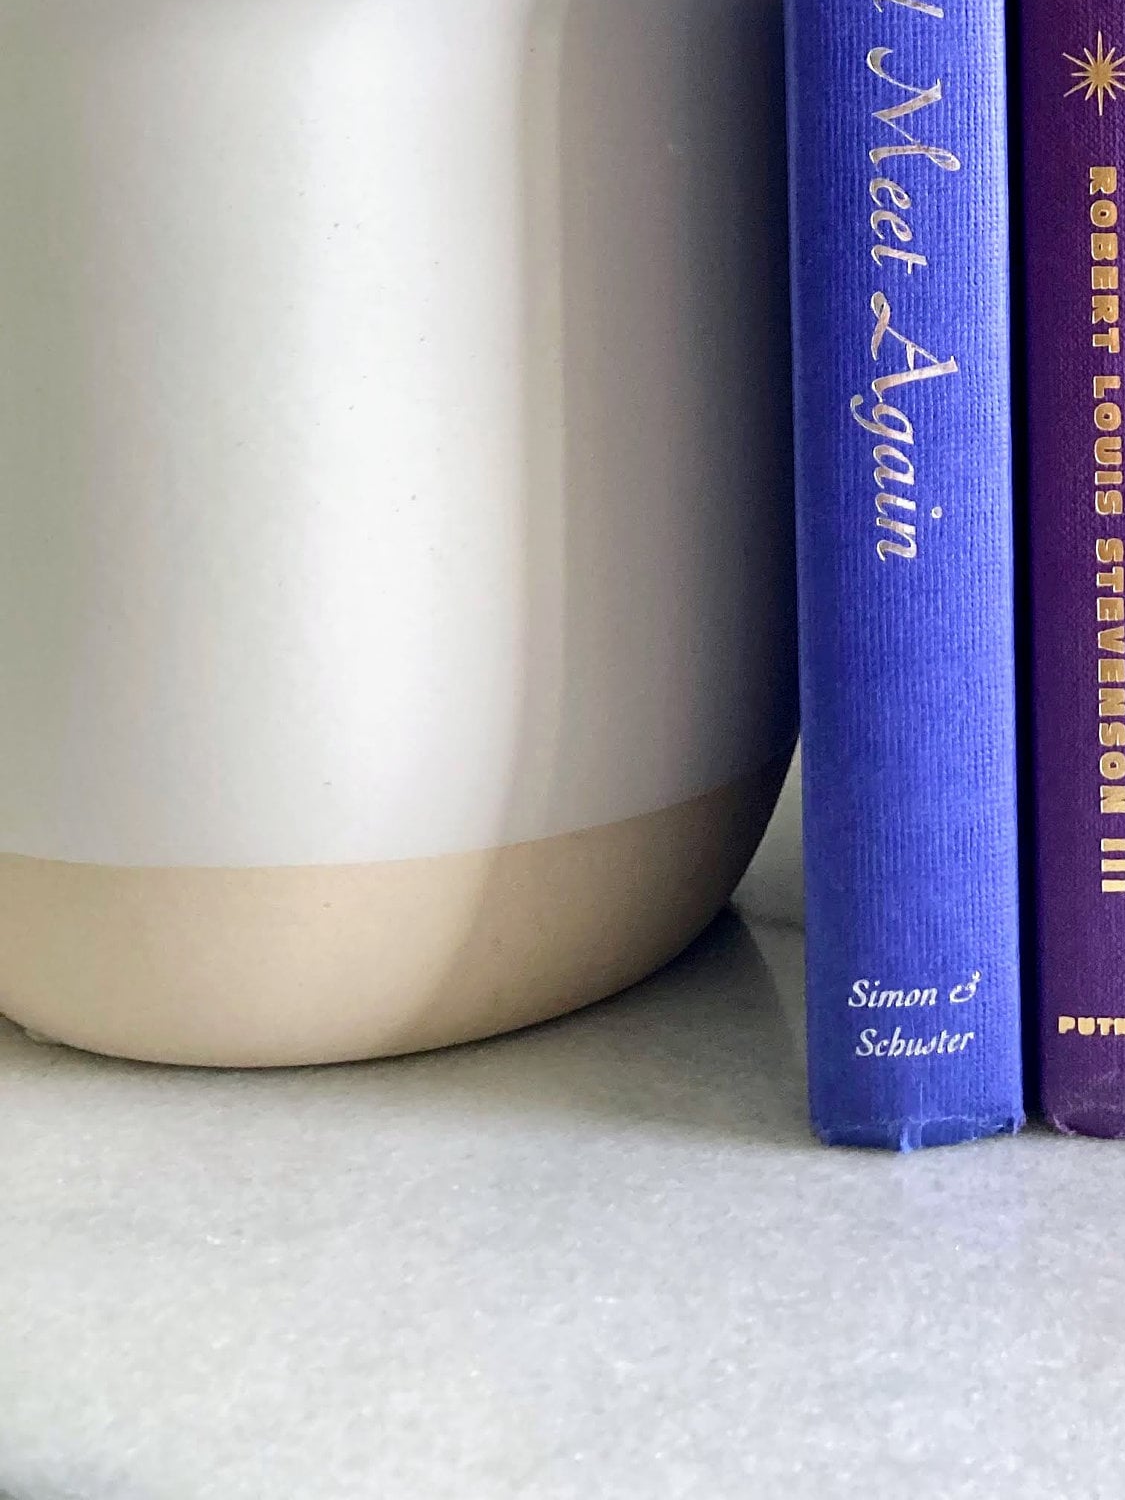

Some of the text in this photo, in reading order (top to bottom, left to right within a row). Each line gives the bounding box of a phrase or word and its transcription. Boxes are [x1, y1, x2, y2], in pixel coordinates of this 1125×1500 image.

[866, 47, 961, 275] Meet
[1088, 165, 1120, 354] ROBERT
[849, 291, 958, 562] Again
[1092, 375, 1123, 515] LOUIS
[847, 970, 981, 1008] Simon &
[854, 1027, 974, 1058] Schuster
